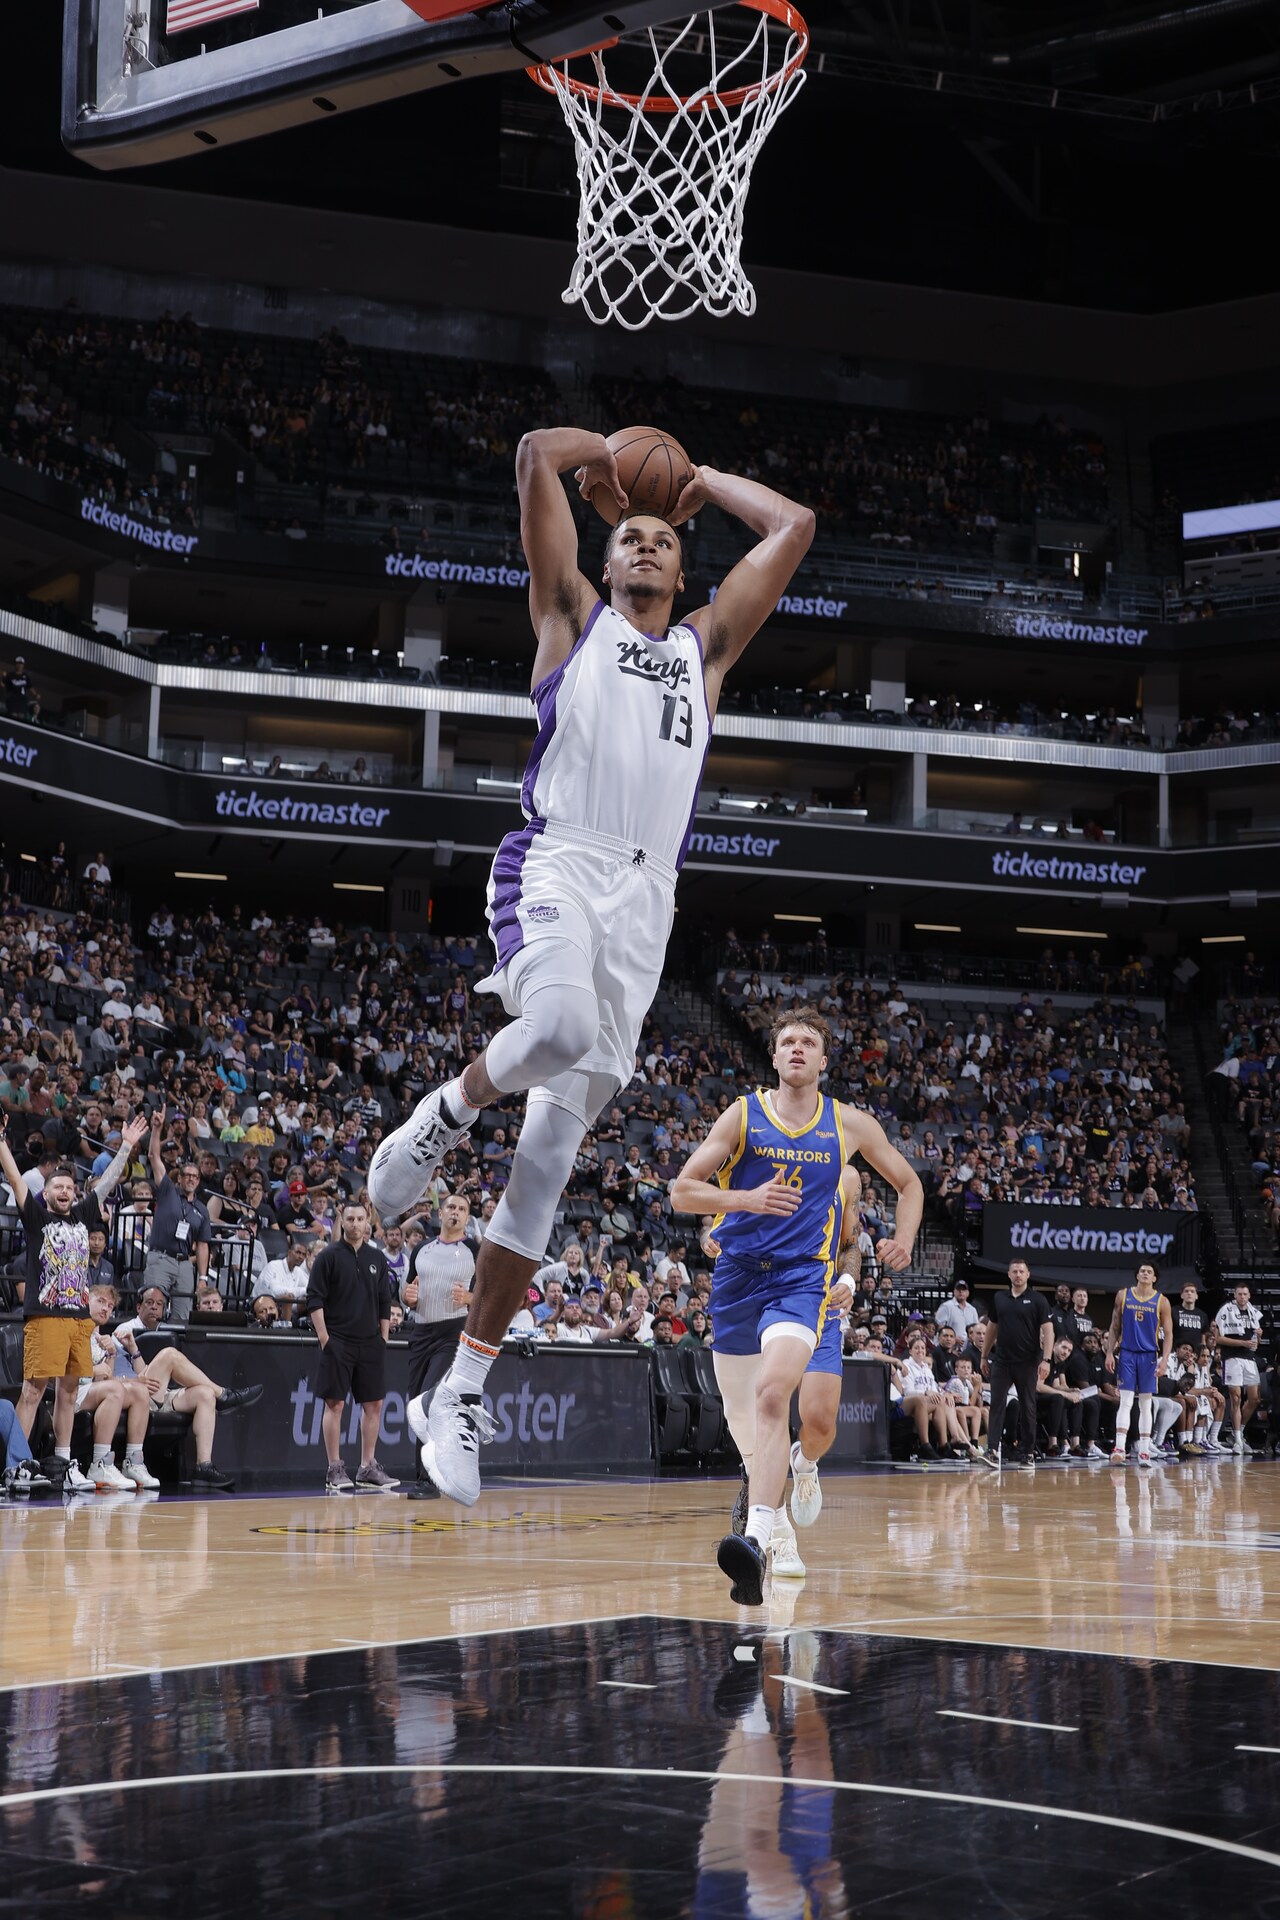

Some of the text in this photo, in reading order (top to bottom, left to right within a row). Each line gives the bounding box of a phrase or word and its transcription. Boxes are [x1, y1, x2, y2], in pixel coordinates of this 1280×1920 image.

[81, 497, 198, 553] ticketmaster
[384, 552, 531, 587] ticketmaster
[1014, 614, 1148, 645] ticketmaster
[658, 693, 693, 748] 13
[215, 790, 390, 827] ticketmaster
[992, 850, 1146, 885] ticketmaster
[752, 1145, 831, 1163] WARRIORS
[1010, 1220, 1174, 1255] ticketmaster
[1126, 1303, 1155, 1313] WARRIORS
[1134, 1311, 1144, 1322] 15
